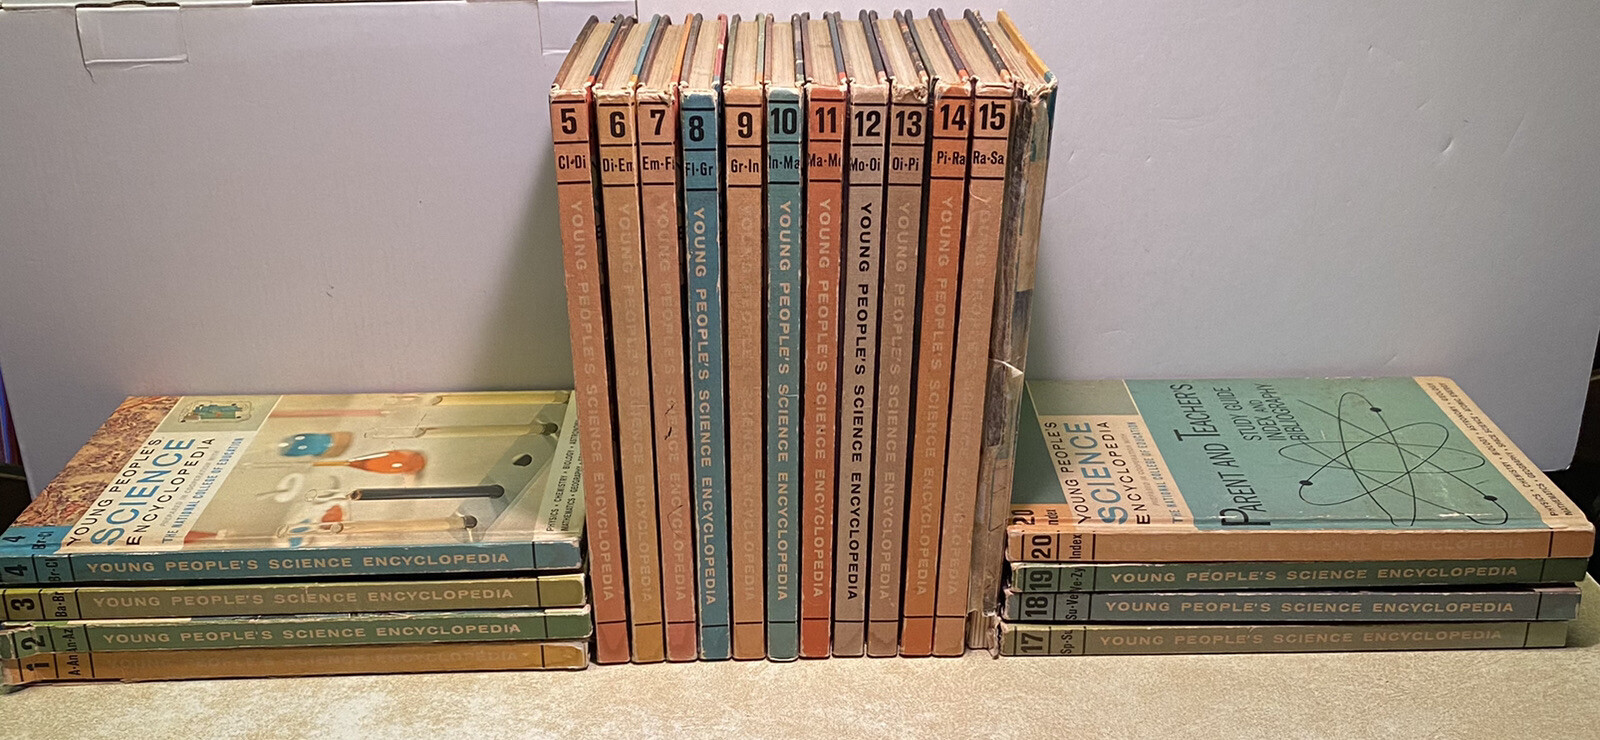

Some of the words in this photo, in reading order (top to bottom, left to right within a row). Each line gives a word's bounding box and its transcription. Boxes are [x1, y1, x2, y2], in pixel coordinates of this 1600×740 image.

[561, 108, 577, 134] 5
[610, 111, 625, 138] 6
[650, 109, 666, 135] 7
[689, 116, 704, 142] 8
[738, 112, 752, 138] 9
[771, 108, 796, 134] 10
[816, 107, 836, 133] 11
[854, 110, 881, 137] 12
[896, 110, 922, 137] 13
[940, 104, 966, 130] 14
[979, 102, 1006, 130] 15
[570, 200, 587, 270] YOUNG
[694, 207, 707, 277] YOUNG
[780, 200, 791, 270] YOUNG
[819, 199, 831, 268] YOUNG
[858, 202, 872, 272] YOUNG
[896, 202, 910, 272] YOUNG
[938, 196, 953, 267] YOUNG
[578, 282, 596, 374] PEOPLE'S
[696, 288, 710, 380] PEOPLE'S
[778, 283, 790, 374] PEOPLE'S
[817, 280, 829, 372] PEOPLE'S
[854, 284, 868, 375] PEOPLE'S
[890, 284, 905, 375] PEOPLE'S
[932, 278, 948, 370] PEOPLE'S
[586, 384, 602, 462] SCIENCE
[778, 384, 790, 462] SCIENCE
[816, 382, 827, 460] SCIENCE
[852, 386, 864, 462] SCIENCE
[886, 385, 899, 463] SCIENCE
[926, 381, 940, 458] SCIENCE
[1170, 383, 1220, 442] TEACHER'S
[1212, 386, 1244, 410] GUIDE
[1250, 400, 1268, 413] AND
[1254, 383, 1310, 442] BIBLIOGRAPHY
[699, 392, 712, 467] SCIENCE
[1044, 422, 1072, 473] PEOPLE'S
[1230, 416, 1262, 441] STUDY
[1254, 416, 1287, 441] INDEX
[1063, 422, 1128, 525] SCIENCE
[1098, 422, 1150, 525] ENCYCLOPEDIA
[1204, 443, 1240, 468] AND
[66, 500, 112, 546] YOUNG
[109, 440, 162, 492] PEOPLE'S
[90, 438, 196, 546] SCIENCE
[126, 438, 215, 546] ENCYCLOPEDIA
[1011, 510, 1035, 526] 20
[1064, 478, 1092, 524] YOUNG
[1169, 510, 1184, 524] THE
[1218, 472, 1271, 526] PARENT
[1532, 494, 1558, 516] PHYSICS
[162, 530, 178, 544] THE
[594, 472, 614, 600] ENCYCLOPEDIA
[670, 473, 686, 601] ENCYCLOPEDIA
[702, 477, 716, 604] ENCYCLOPEDIA
[778, 472, 788, 600] ENCYCLOPEDIA
[813, 470, 826, 597] ENCYCLOPEDIA
[848, 472, 861, 600] ENCYCLOPEDIA
[880, 472, 895, 600] ENCYCLOPEDIA
[916, 467, 934, 596] ENCYCLOPEDIA
[1032, 534, 1052, 560] 20
[1069, 534, 1082, 559] Index
[4, 564, 28, 576] 4
[86, 562, 155, 573] YOUNG
[165, 560, 258, 572] PEOPLE'S
[268, 557, 352, 570] SCIENCE
[363, 554, 510, 567] ENCYCLOPEDIA
[1029, 570, 1052, 590] 19
[1111, 572, 1176, 583] YOUNG
[1186, 571, 1276, 582] PEOPLE'S
[1286, 569, 1368, 580] SCIENCE
[1378, 566, 1518, 579] ENCYCLOPEDIA
[11, 598, 34, 610] 3
[94, 596, 160, 608] YOUNG
[172, 594, 264, 606] PEOPLE'S
[274, 592, 357, 605] SCIENCE
[368, 589, 513, 602] ENCYCLOPEDIA
[1025, 596, 1048, 617] 18
[1106, 602, 1170, 612] YOUNG
[1181, 602, 1271, 612] PEOPLE'S
[1281, 602, 1362, 613] SCIENCE
[1372, 602, 1514, 613] ENCYCLOPEDIA
[21, 635, 46, 650] 2
[103, 633, 170, 644] YOUNG
[180, 630, 273, 642] PEOPLE'S
[282, 628, 366, 640] SCIENCE
[376, 624, 521, 637] ENCYCLOPEDIA
[1020, 632, 1044, 653] 17
[1100, 636, 1164, 646] YOUNG
[1174, 634, 1263, 645] PEOPLE'S
[1272, 632, 1352, 644] SCIENCE
[1362, 630, 1502, 642] ENCYCLOPEDIA
[26, 662, 50, 672] 1
